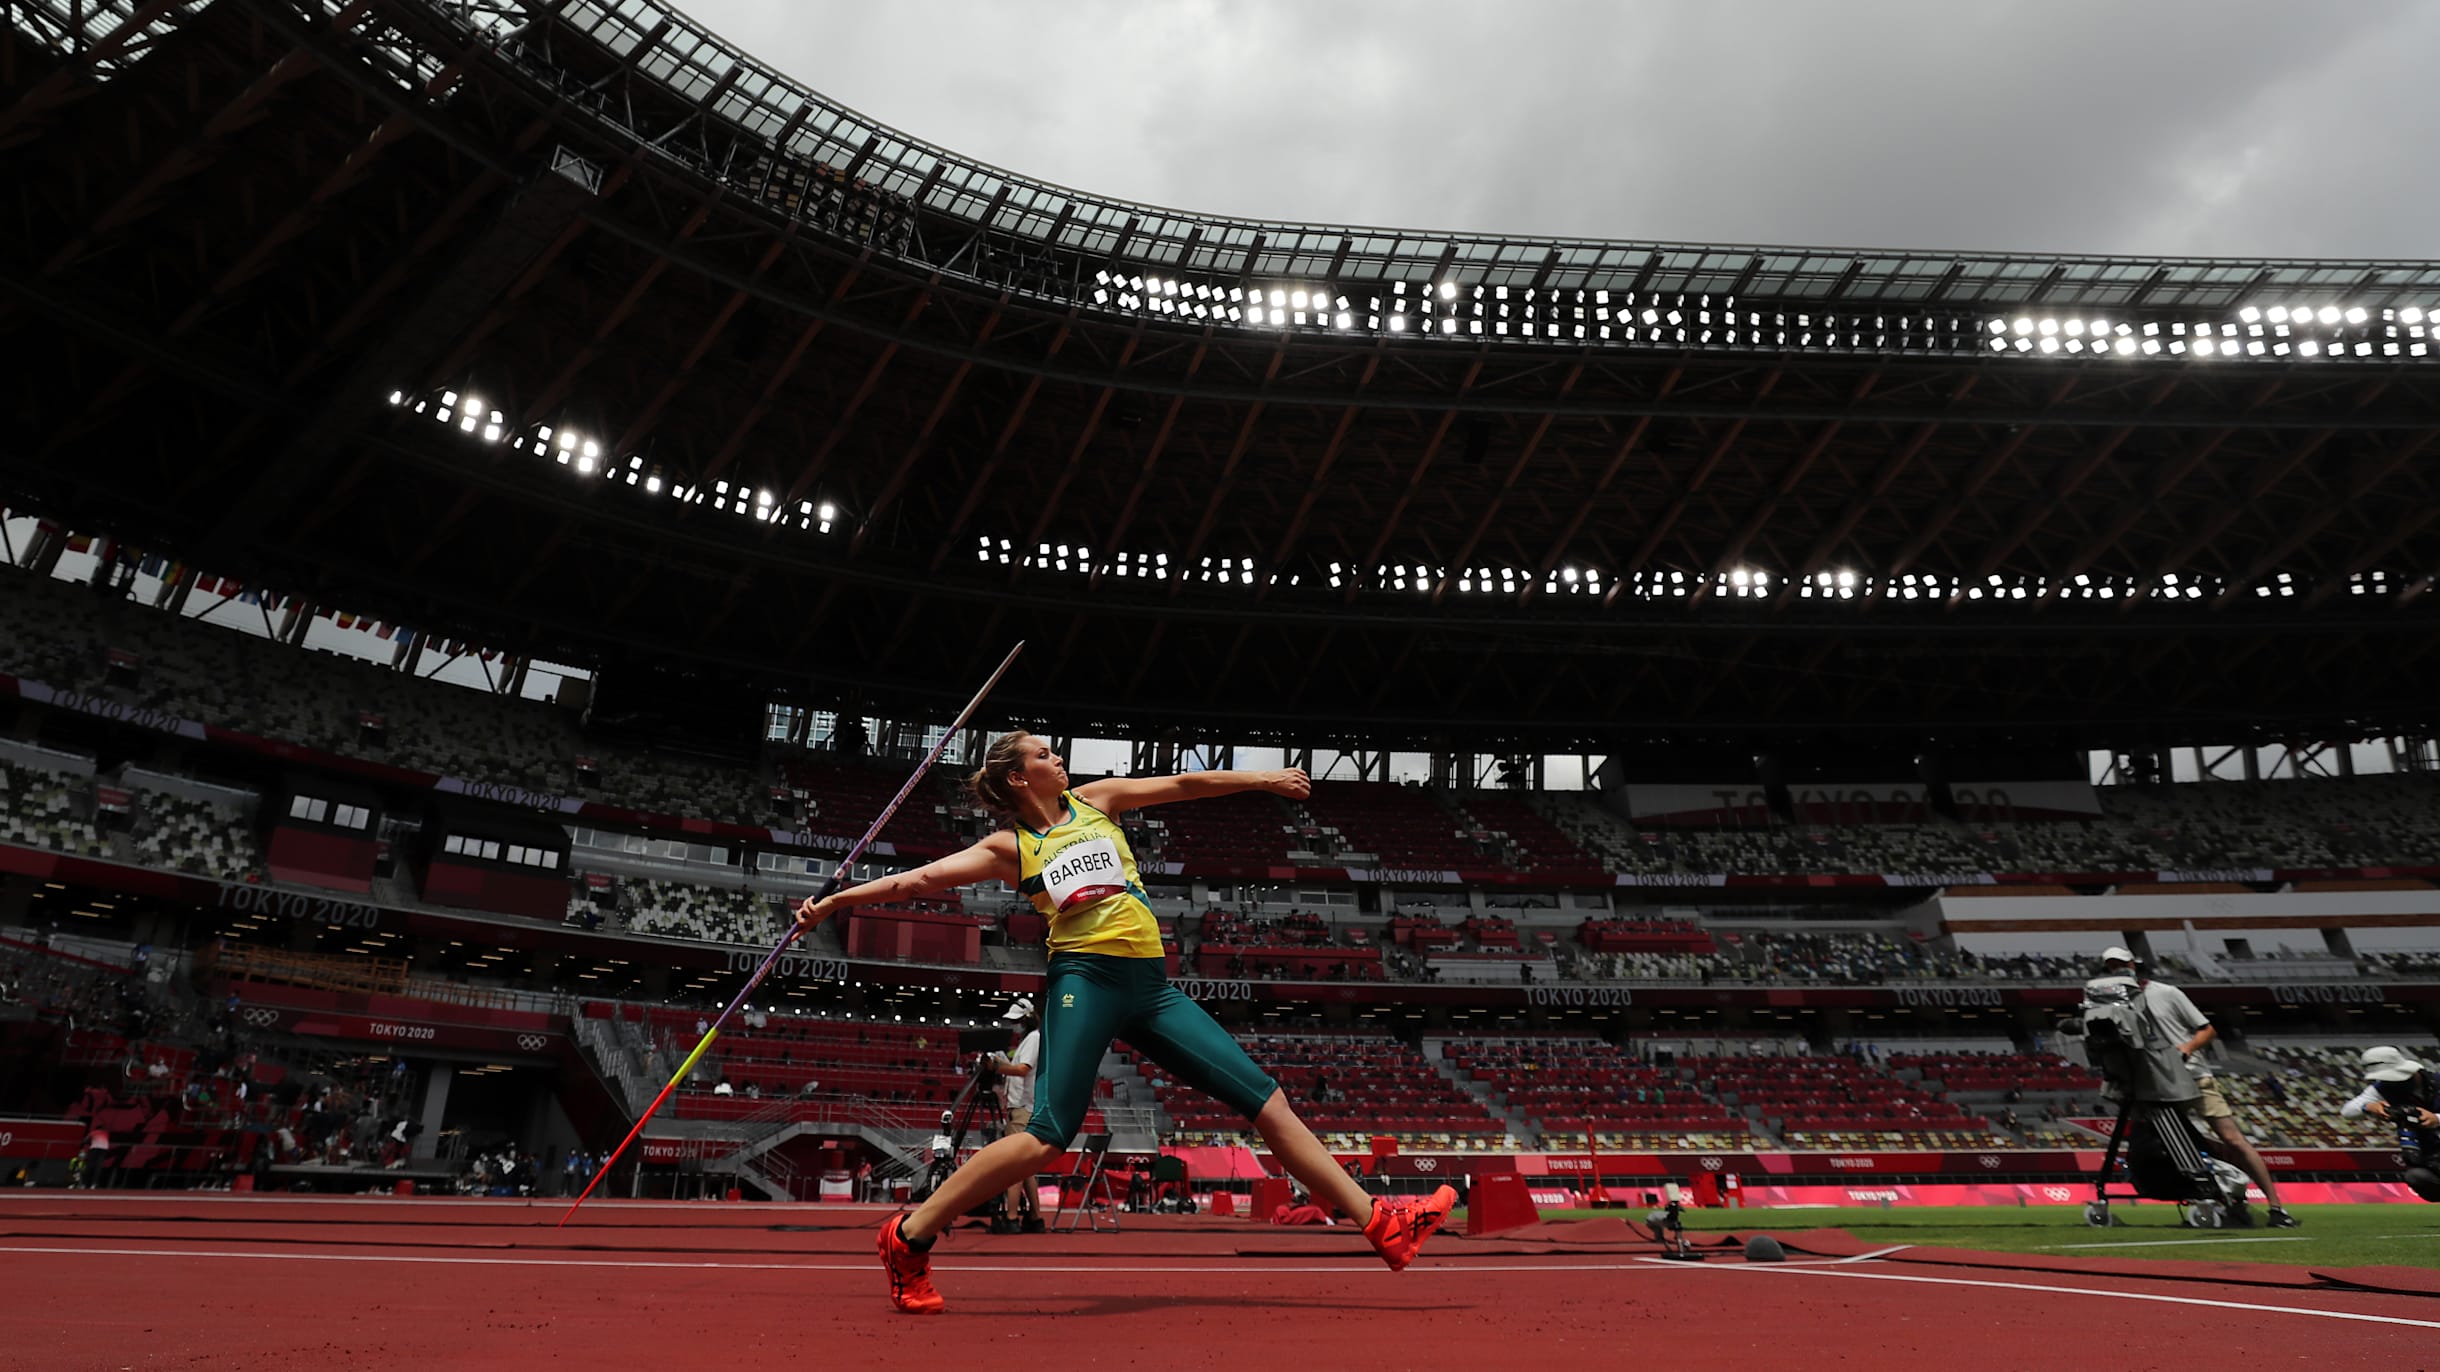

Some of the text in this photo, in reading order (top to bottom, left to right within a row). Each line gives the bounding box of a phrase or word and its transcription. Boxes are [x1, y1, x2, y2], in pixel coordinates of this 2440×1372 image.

[51, 688, 181, 733] TOKYO 2020
[461, 779, 561, 811] TOKYO 2020
[793, 832, 877, 854] TOKYO 200
[1049, 851, 1114, 886] BARBER
[1137, 861, 1166, 874] 020
[1367, 869, 1443, 884] TOKYO 2020
[217, 884, 380, 929] TOKYO 2020
[798, 958, 849, 981] 2020
[1205, 982, 1252, 1000] 2020
[1523, 988, 1632, 1006] TOKYO 2020
[1894, 988, 2002, 1007] TOKYO 2020
[2271, 985, 2385, 1005] TOKYO 2020
[369, 1022, 435, 1040] TOKYO 2020
[643, 1145, 674, 1157] TOKYO
[1548, 1159, 1573, 1169] TOKYO
